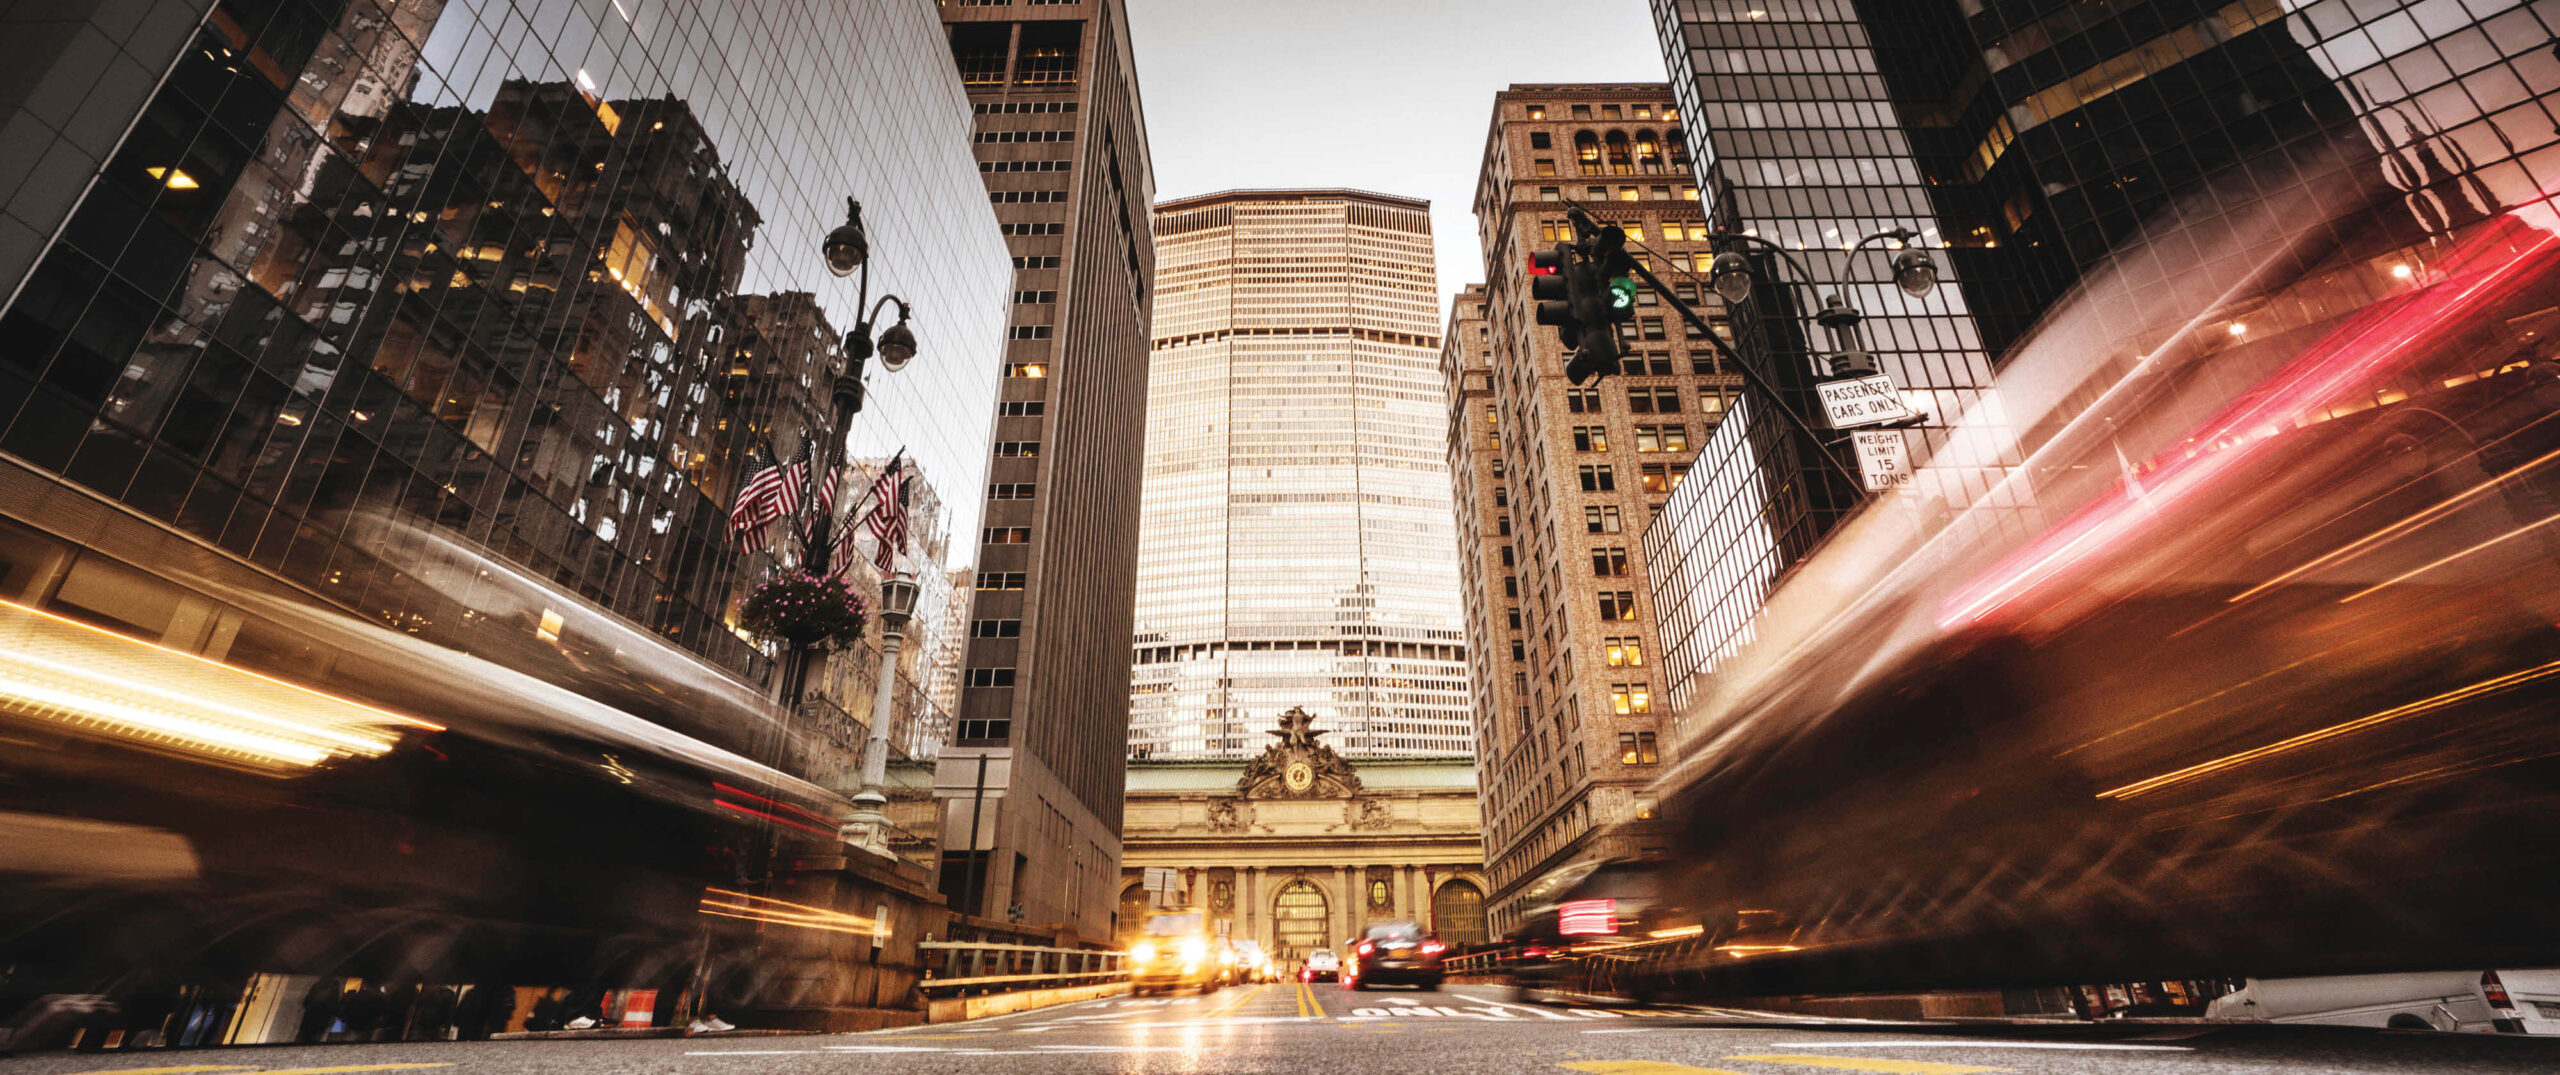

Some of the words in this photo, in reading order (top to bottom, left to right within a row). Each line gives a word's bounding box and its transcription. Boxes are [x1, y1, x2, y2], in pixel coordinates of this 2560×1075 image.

[1825, 381, 1892, 402] PASSENGER
[1832, 403, 1864, 419] CARS
[1868, 397, 1898, 414] ONLY
[1857, 434, 1899, 445] WEIGHT
[1867, 446, 1896, 457] LIMIT
[1877, 459, 1895, 470] 15
[1871, 473, 1909, 486] TONS
[1351, 1006, 1519, 1018] ONLY
